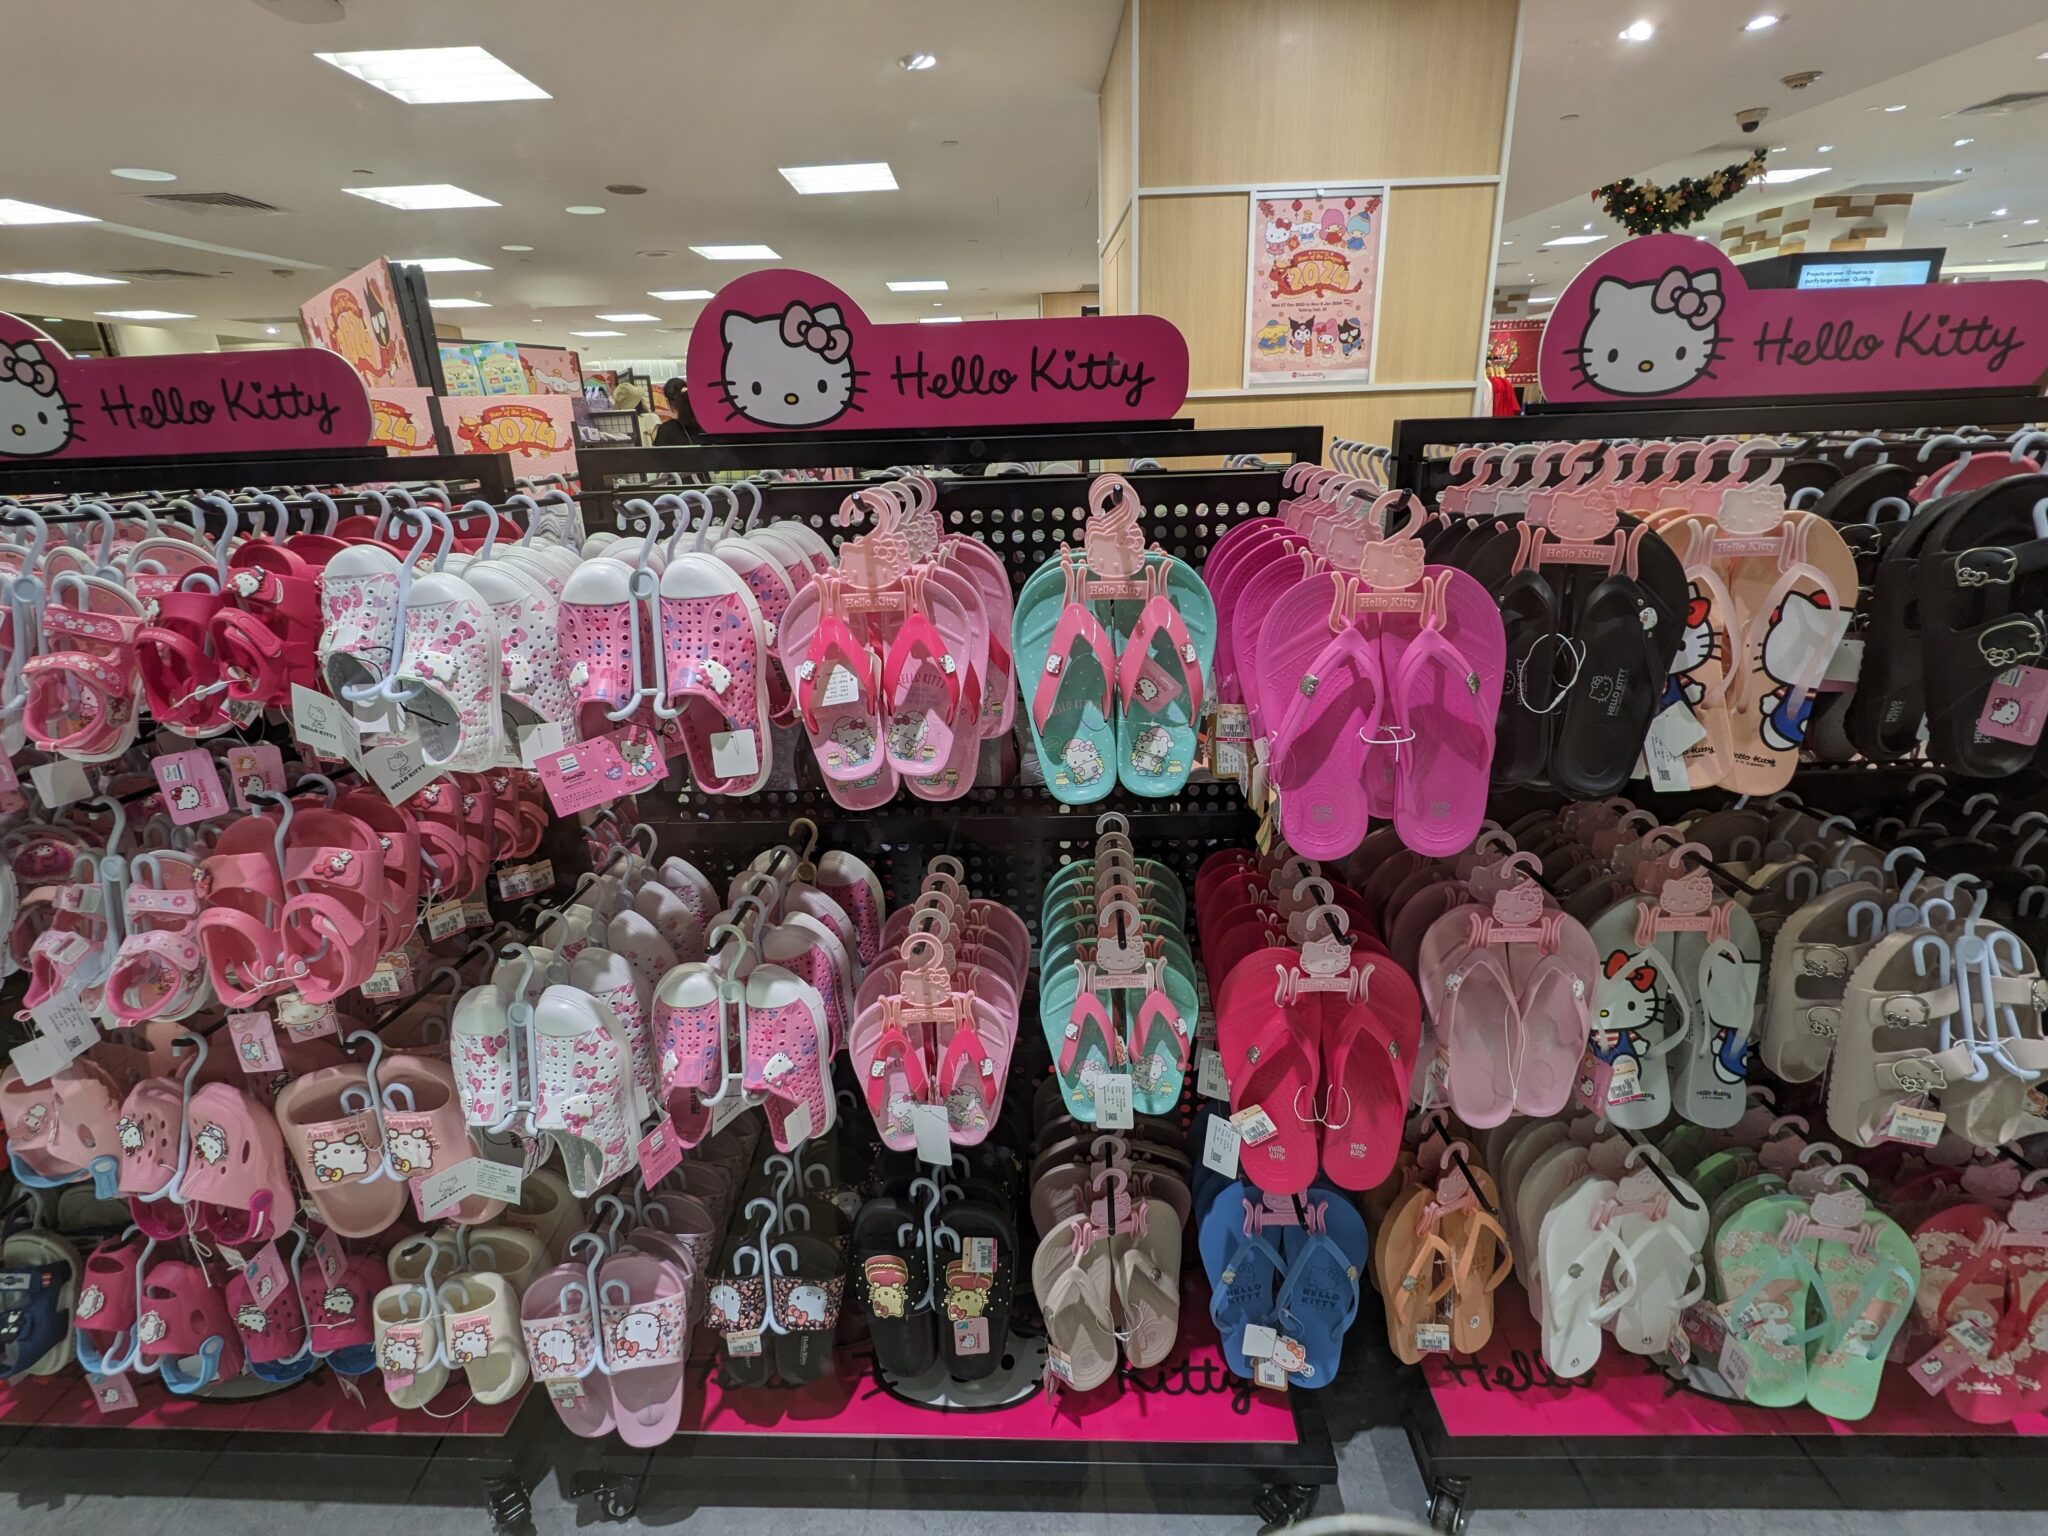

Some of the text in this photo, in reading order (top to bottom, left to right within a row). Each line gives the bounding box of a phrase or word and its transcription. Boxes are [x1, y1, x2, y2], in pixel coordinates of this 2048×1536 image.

[1289, 260, 1351, 291] 2024
[1753, 310, 2025, 372] Hello Kitty
[890, 345, 1155, 407] Hello Kitty
[100, 378, 340, 435] Hello Kitty
[488, 410, 503, 420] Year
[521, 409, 544, 421] Dragon
[374, 411, 417, 447] 24
[482, 417, 557, 450] 2024
[1716, 540, 1778, 553] Hello Kitty
[1545, 547, 1608, 562] Hello Kitty
[1089, 584, 1143, 596] Hello Kitty
[845, 596, 900, 609] Hello Kitty
[1359, 597, 1418, 609] Hello Kitty
[899, 671, 921, 686] ELLO
[1607, 691, 1620, 717] HELLO
[1614, 667, 1628, 692] KITTY
[300, 723, 338, 740] HELLO KITTY
[390, 763, 426, 791] HELLO KITTY
[1268, 1144, 1286, 1154] Hello
[1350, 1142, 1367, 1152] Hello
[1350, 1149, 1367, 1159] Kitty
[1268, 1151, 1287, 1162] Kitty
[430, 1195, 448, 1208] HELLO
[448, 1185, 467, 1197] KITTY
[1302, 1287, 1340, 1300] HELLO
[1301, 1295, 1338, 1309] KITTY
[1118, 1357, 1257, 1415] Kitty
